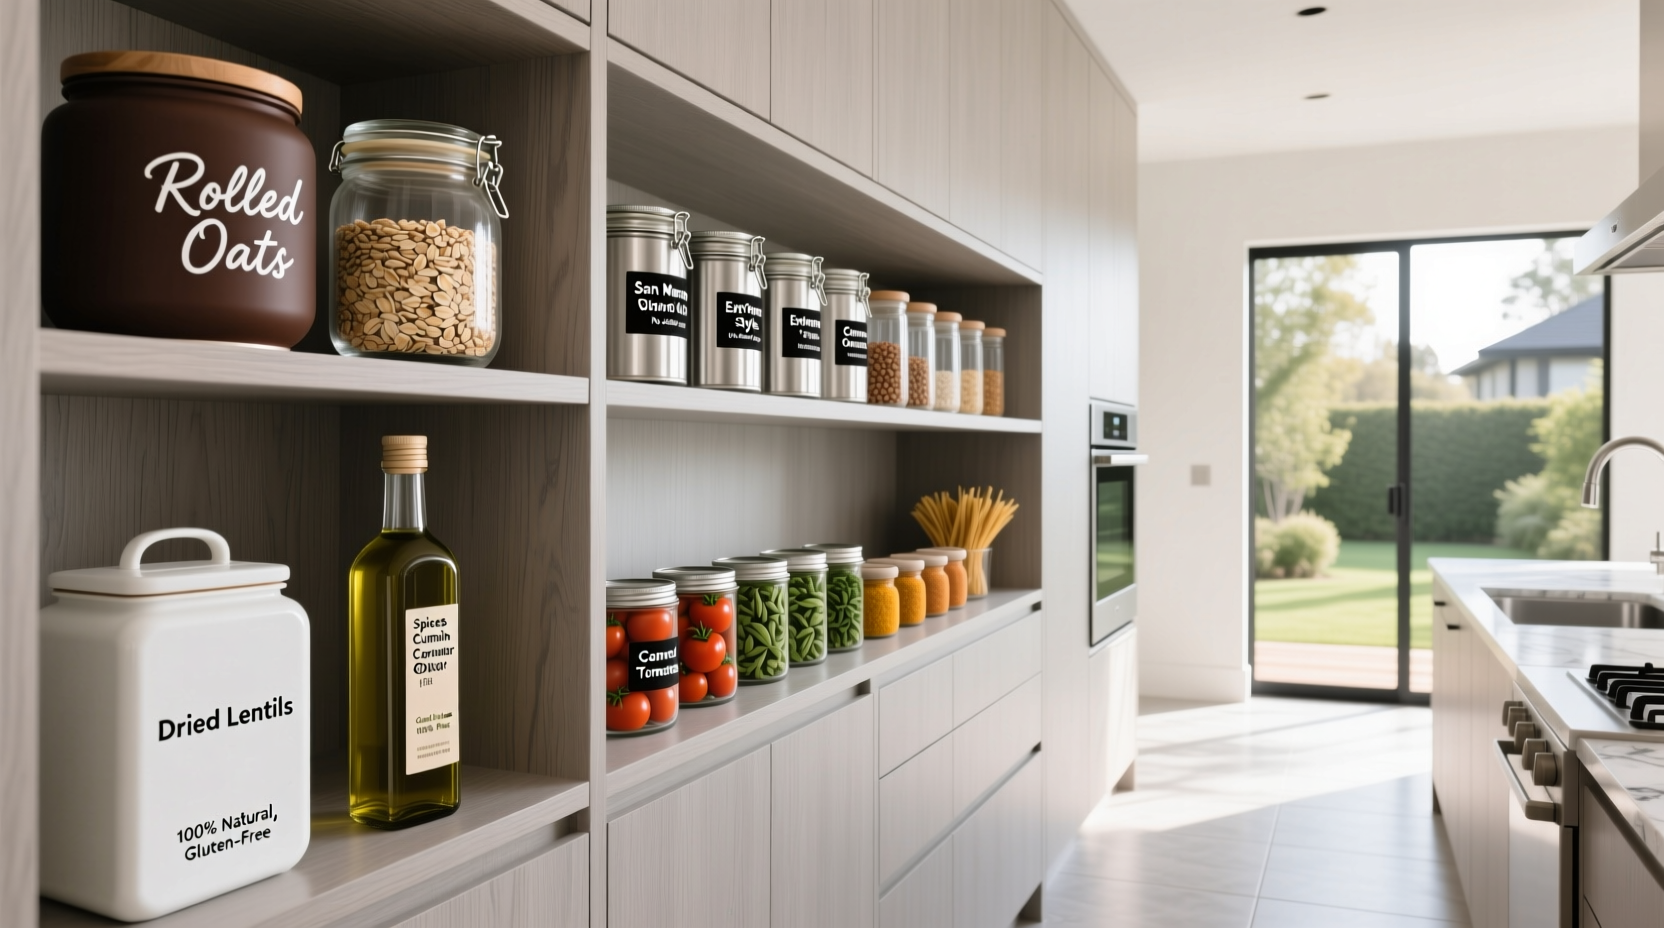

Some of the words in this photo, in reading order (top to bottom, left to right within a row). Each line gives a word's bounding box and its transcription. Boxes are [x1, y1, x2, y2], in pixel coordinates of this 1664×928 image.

[144, 152, 304, 225] Rolled
[181, 218, 294, 279] Oats
[634, 280, 659, 296] San
[413, 616, 448, 633] Spices
[158, 708, 220, 742] Dried
[227, 695, 294, 727] Lentils
[177, 820, 218, 843] 100%
[222, 803, 278, 832] Natural,
[184, 828, 271, 861] Gluten-Free
